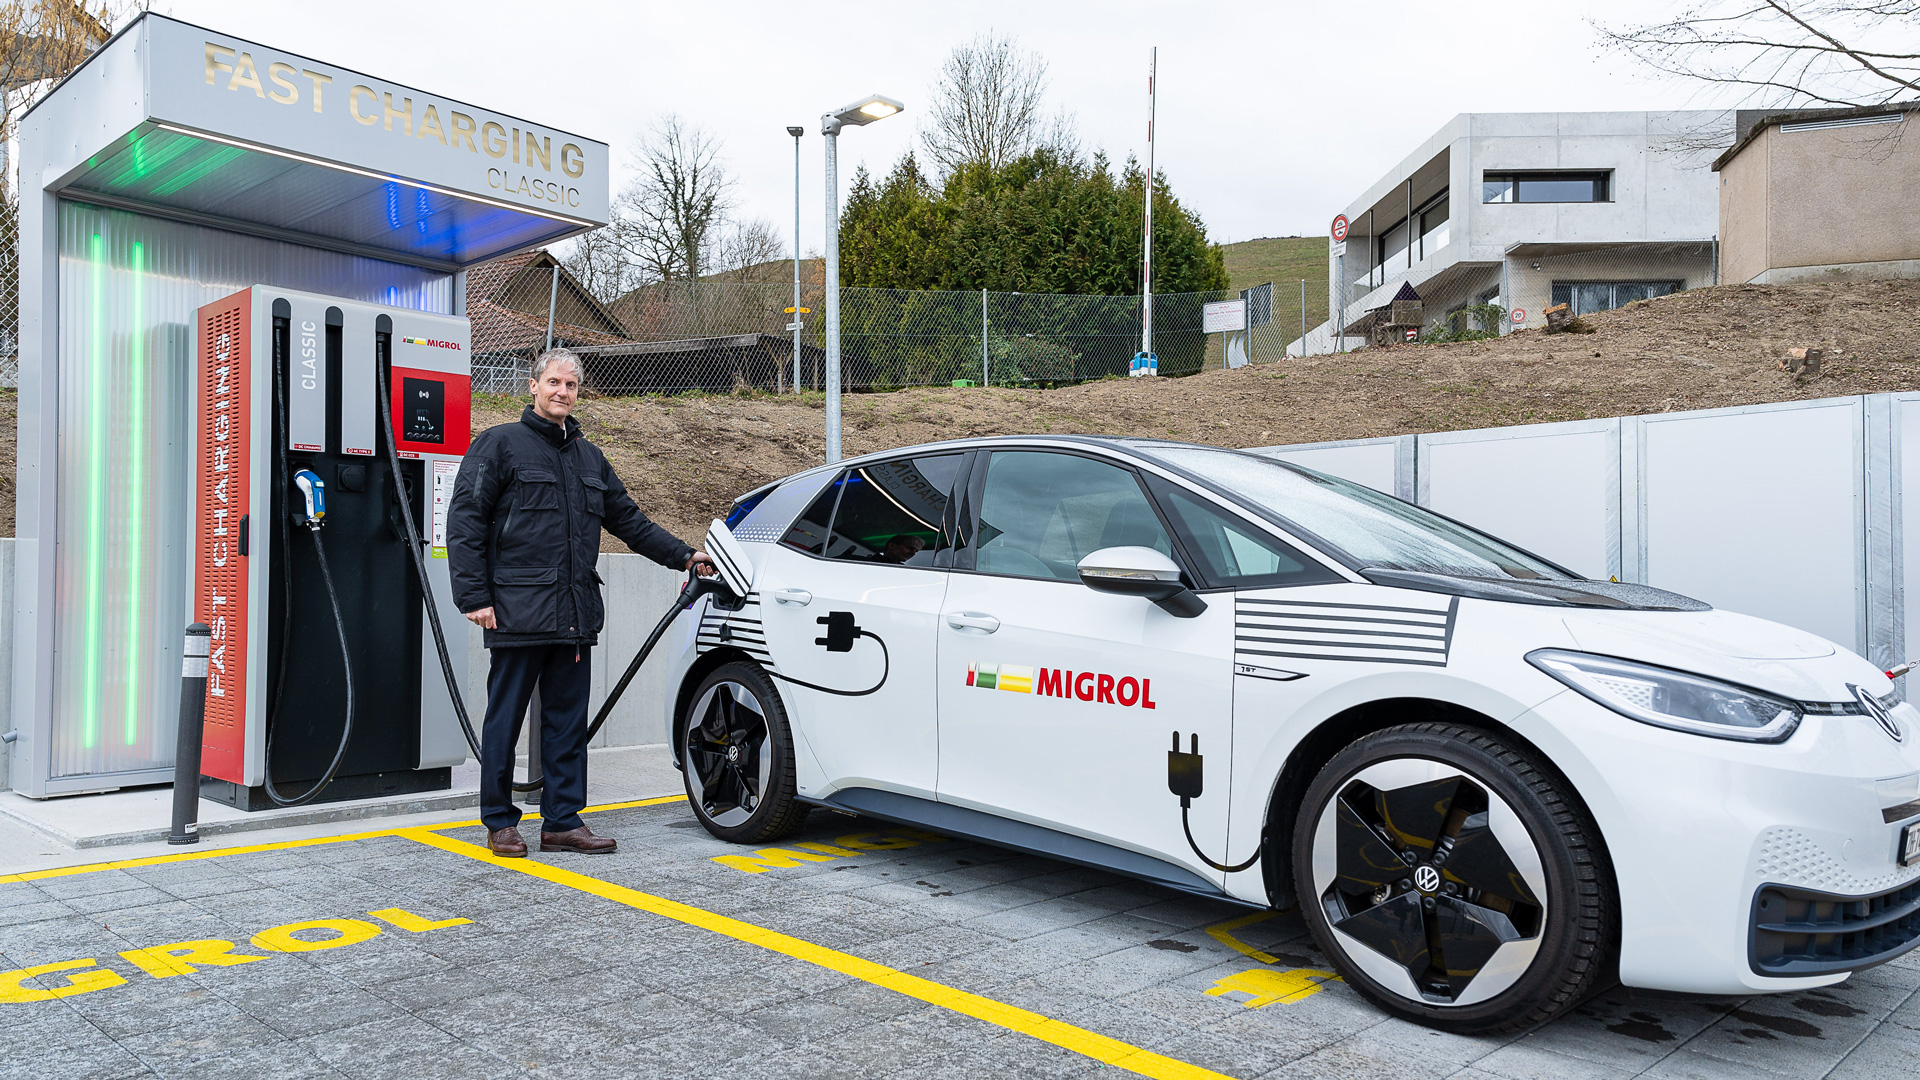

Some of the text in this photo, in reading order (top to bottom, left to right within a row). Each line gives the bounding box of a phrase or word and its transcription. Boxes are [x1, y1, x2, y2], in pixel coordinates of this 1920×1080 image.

[204, 41, 585, 179] FAST CHARGING
[487, 167, 581, 208] CLASSIC
[301, 320, 317, 390] CLASSIC
[426, 338, 461, 351] MIGROL
[210, 333, 231, 698] FAST CHARGING
[1036, 667, 1156, 710] MIGROL
[1414, 865, 1440, 892] VW
